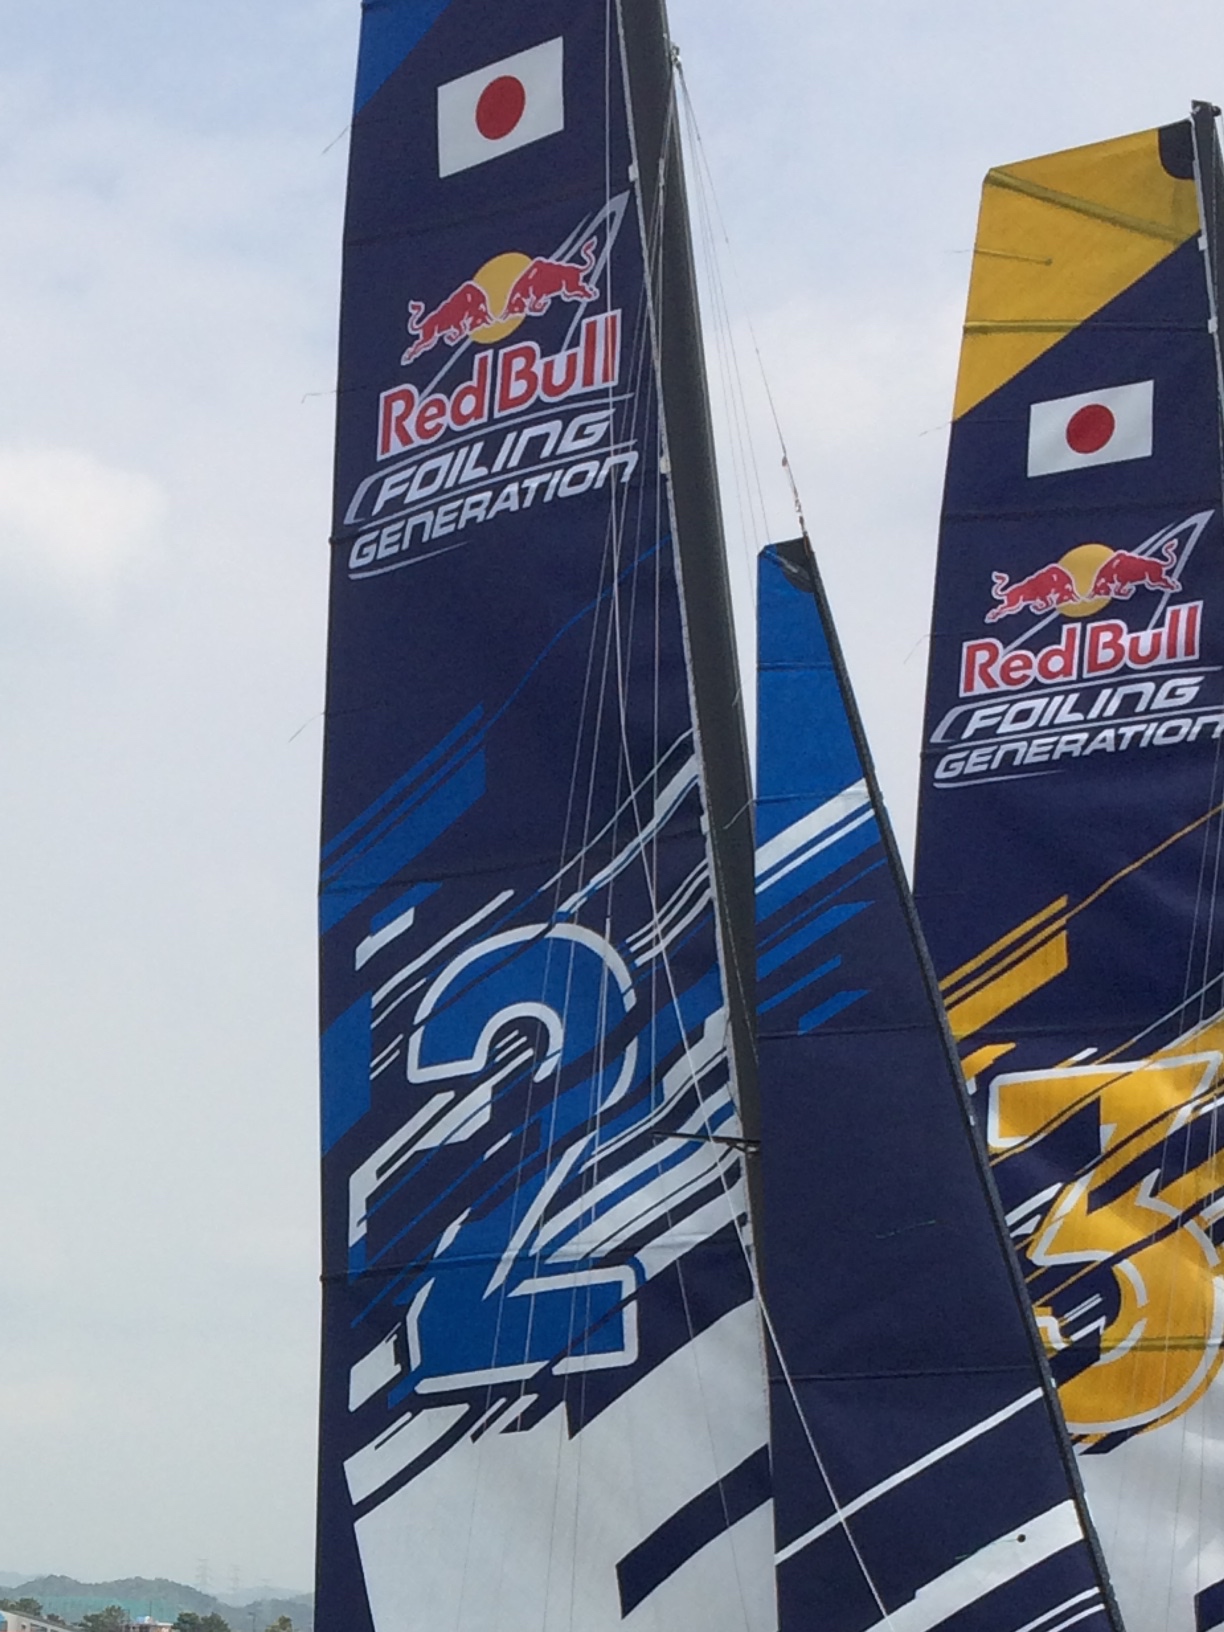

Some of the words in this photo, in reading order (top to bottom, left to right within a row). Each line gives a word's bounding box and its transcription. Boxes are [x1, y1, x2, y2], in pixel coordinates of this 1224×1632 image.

[379, 353, 490, 458] Red
[496, 312, 620, 414] Bull
[348, 452, 638, 568] GENERATION
[961, 624, 1078, 696] Red
[1083, 602, 1203, 677] Bull
